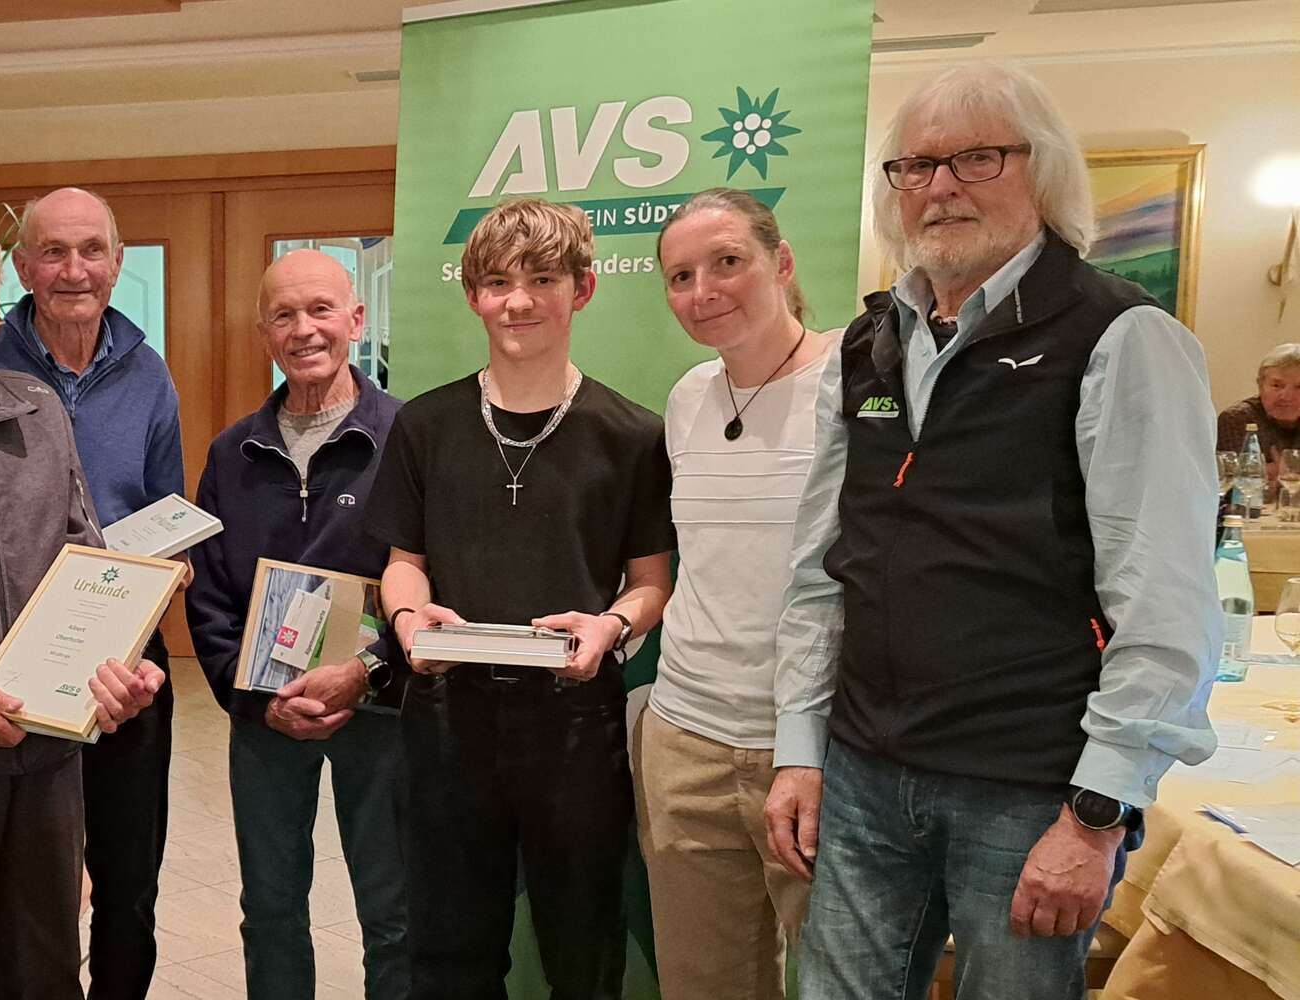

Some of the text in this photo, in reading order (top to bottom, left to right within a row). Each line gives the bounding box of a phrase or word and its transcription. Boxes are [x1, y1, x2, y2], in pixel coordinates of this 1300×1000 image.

[467, 95, 693, 198] AVS
[585, 202, 681, 228] EIN SÜDT
[442, 253, 654, 281] Se nders
[860, 397, 893, 411] AVS
[74, 579, 130, 600] Urkunde
